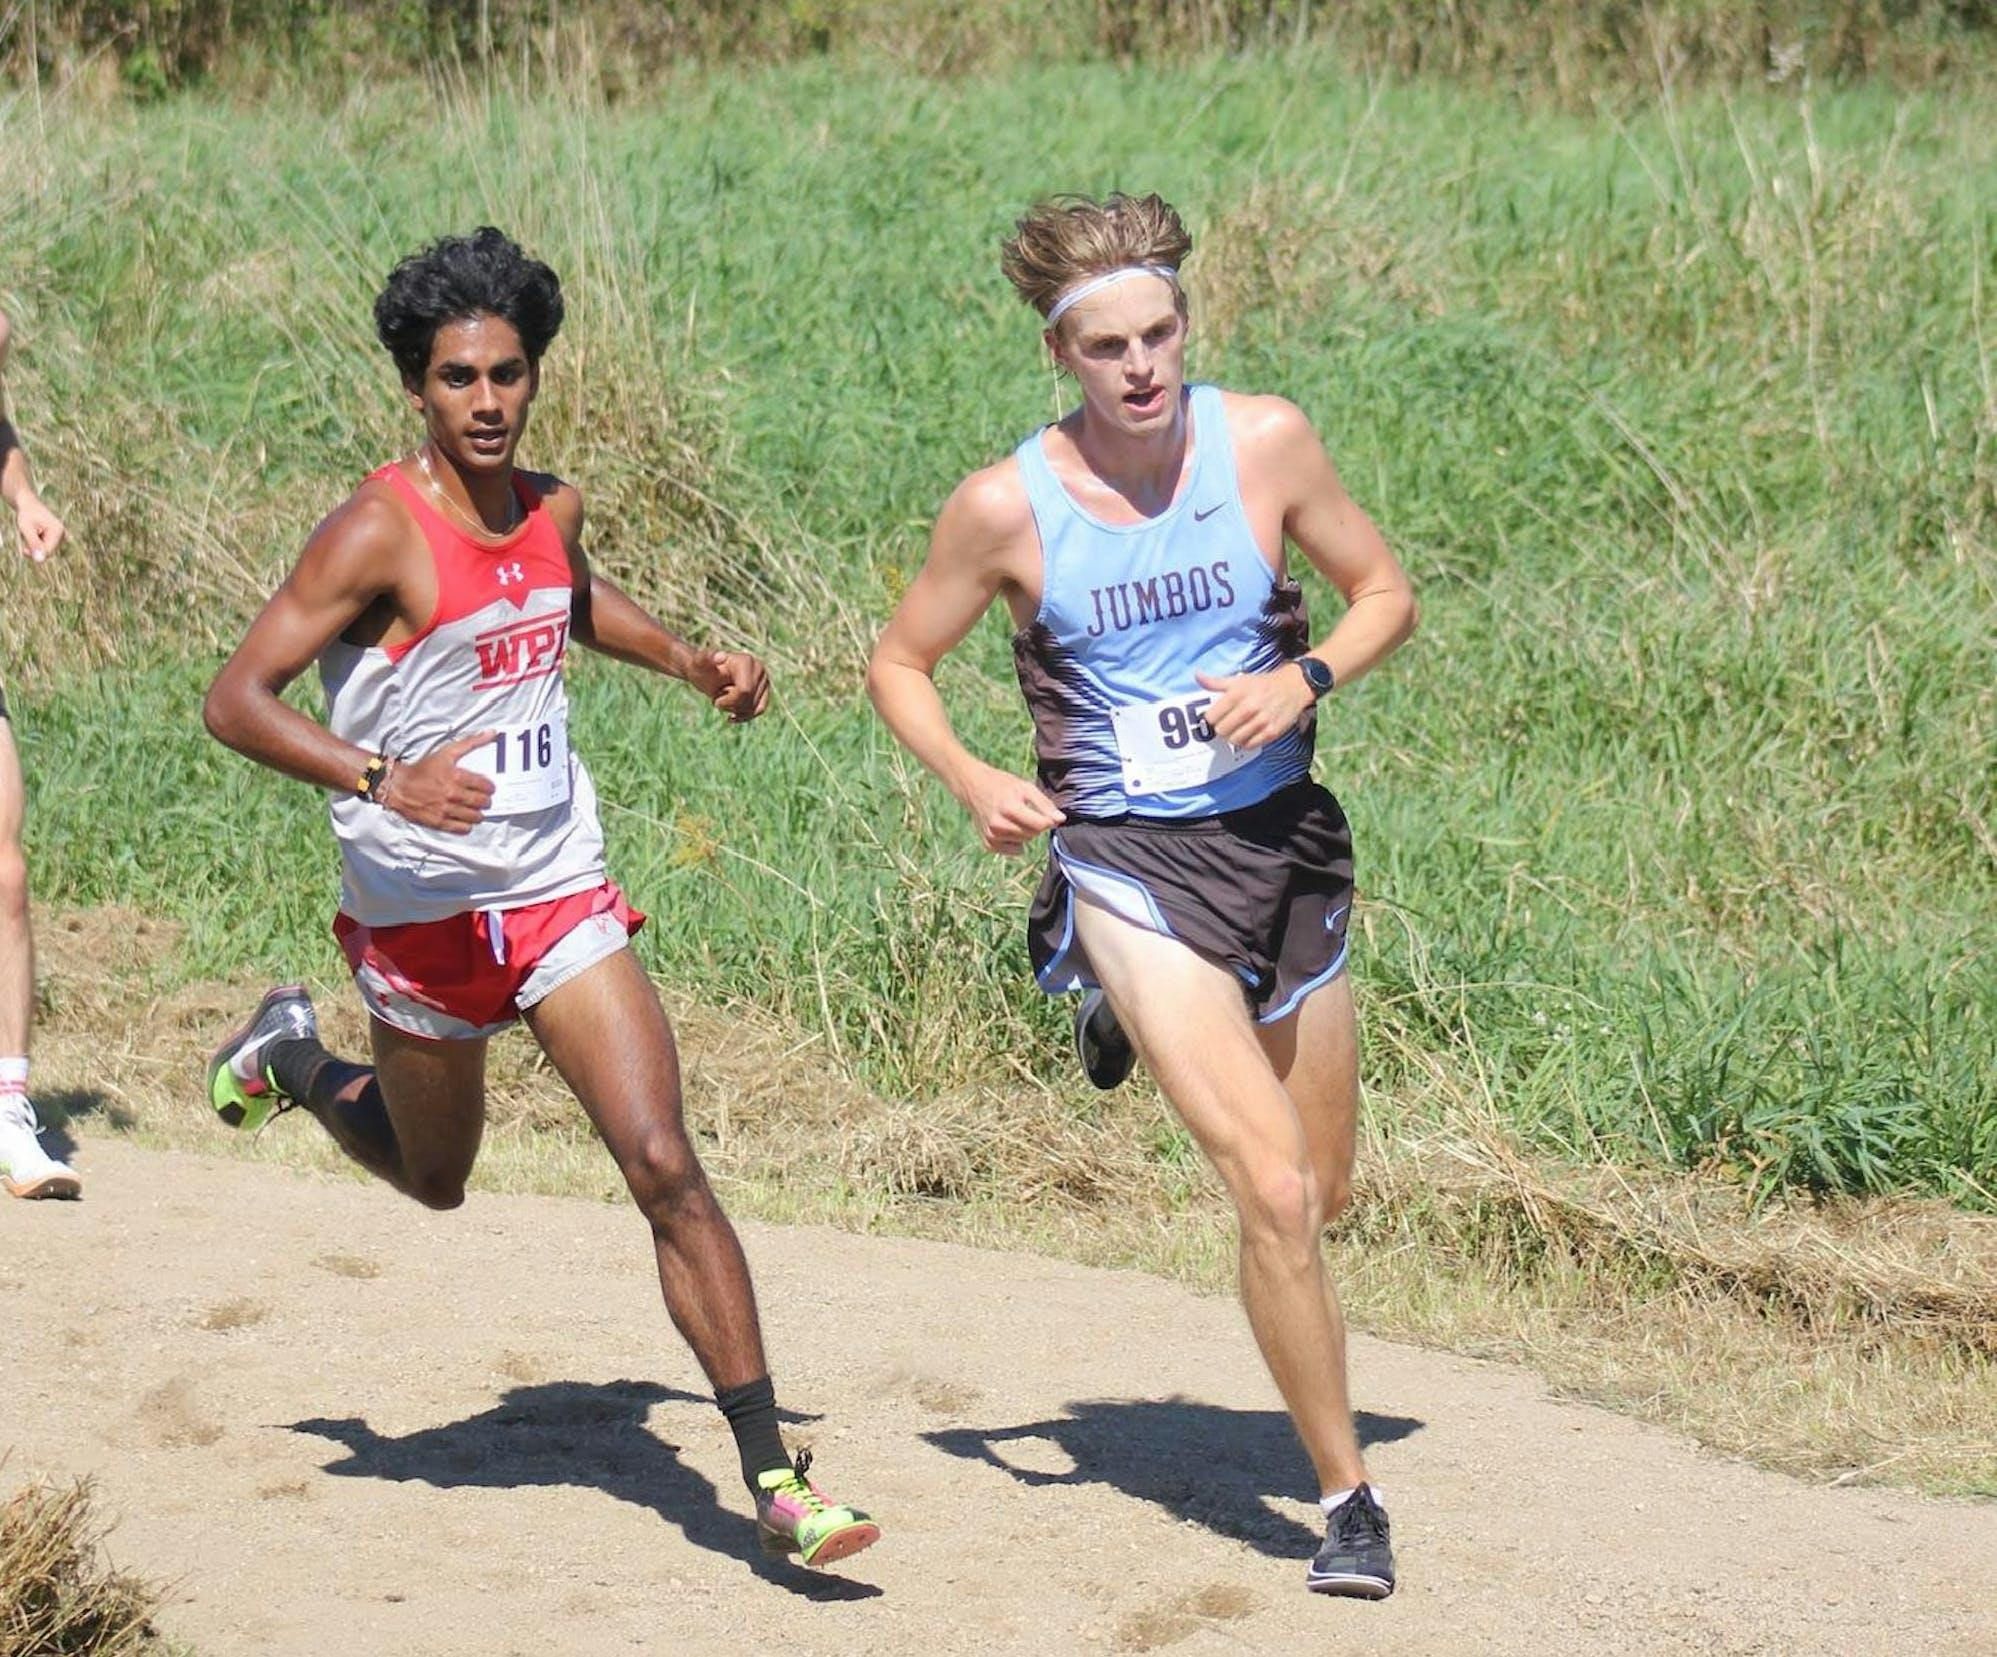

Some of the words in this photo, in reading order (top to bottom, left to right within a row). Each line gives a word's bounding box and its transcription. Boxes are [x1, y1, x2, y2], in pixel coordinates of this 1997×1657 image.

[1087, 561, 1235, 637] JUMBOS
[475, 621, 568, 679] WPI
[495, 723, 551, 774] 116
[1158, 697, 1217, 749] 95
